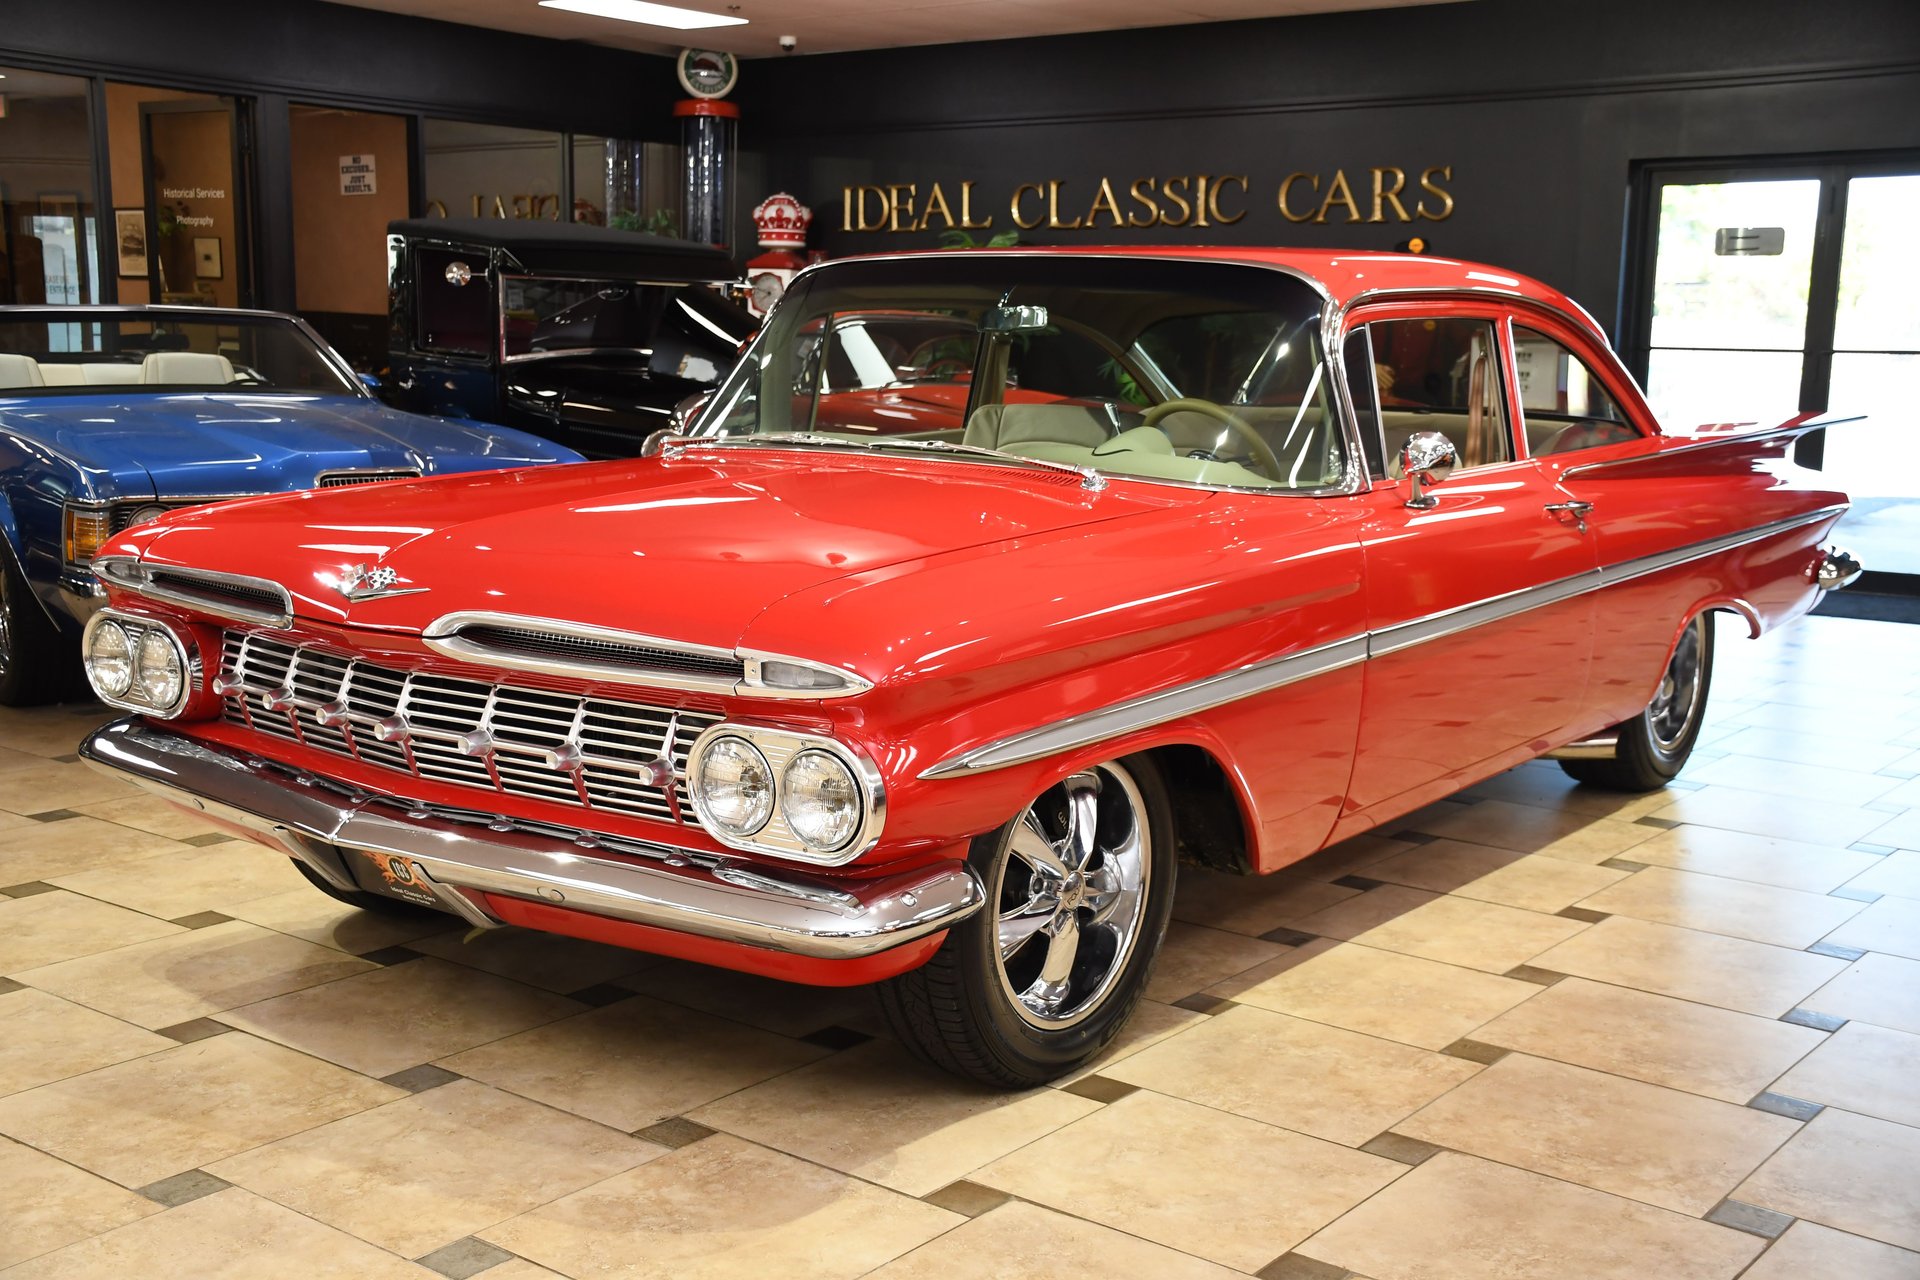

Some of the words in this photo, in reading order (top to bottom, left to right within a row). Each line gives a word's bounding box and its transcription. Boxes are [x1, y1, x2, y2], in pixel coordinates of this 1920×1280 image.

[350, 175, 365, 184] JUST
[163, 188, 195, 198] Historical
[196, 188, 225, 198] Services
[839, 180, 993, 233] IDEAL
[1010, 175, 1248, 230] CLASSIC
[1278, 166, 1454, 224] CARS
[176, 215, 214, 227] Photography
